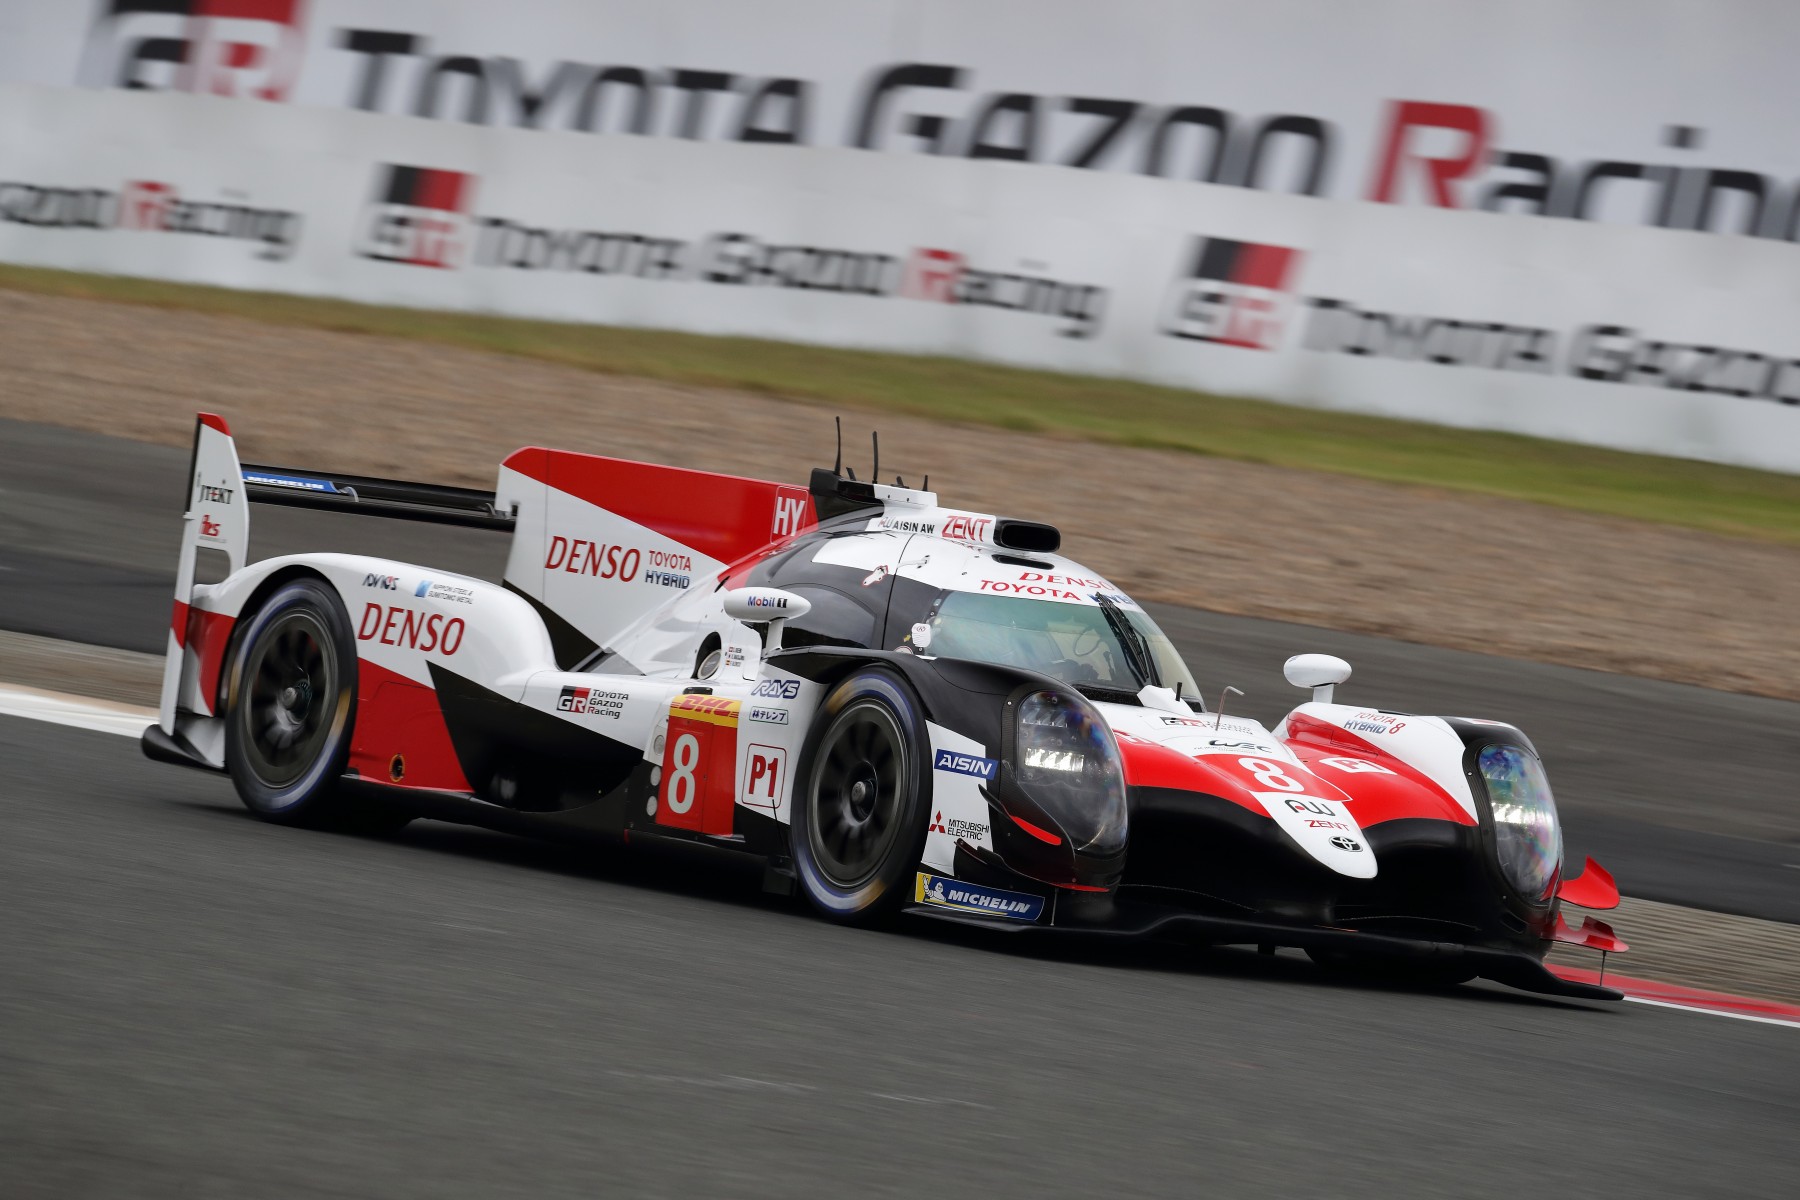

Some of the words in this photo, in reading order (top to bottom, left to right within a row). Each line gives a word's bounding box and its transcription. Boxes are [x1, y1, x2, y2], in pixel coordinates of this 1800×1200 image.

[334, 27, 814, 147] TOYOTA
[1368, 98, 1800, 244] Racin
[773, 497, 806, 537] HY
[893, 521, 919, 532] AISIN
[920, 523, 935, 534] AW
[941, 515, 992, 542] ZENT
[544, 535, 641, 582] DENSO
[649, 550, 692, 571] TOYOTA
[644, 570, 691, 589] HYBRID
[1019, 571, 1115, 591] DENSO
[980, 580, 1081, 601] TOYOTA
[747, 596, 775, 607] Mobil
[358, 602, 465, 656] DENSO
[592, 689, 629, 700] TOYOTA
[751, 680, 800, 699] RAYS
[557, 695, 587, 713] GR
[589, 699, 623, 709] GAZOO
[587, 706, 620, 719] Racing
[679, 695, 735, 716] DHL
[1344, 720, 1388, 735] HYBRID
[1388, 722, 1406, 735] 8
[1354, 712, 1397, 725] TOYOTA
[668, 733, 699, 814] 8
[938, 754, 993, 775] AISIN
[1238, 757, 1305, 792] 8
[748, 755, 778, 798] P1
[947, 828, 982, 841] ELECTRIC
[948, 819, 990, 833] MITSUBISHI
[1304, 819, 1350, 832] ZENT
[948, 889, 1031, 914] MICHELIN
